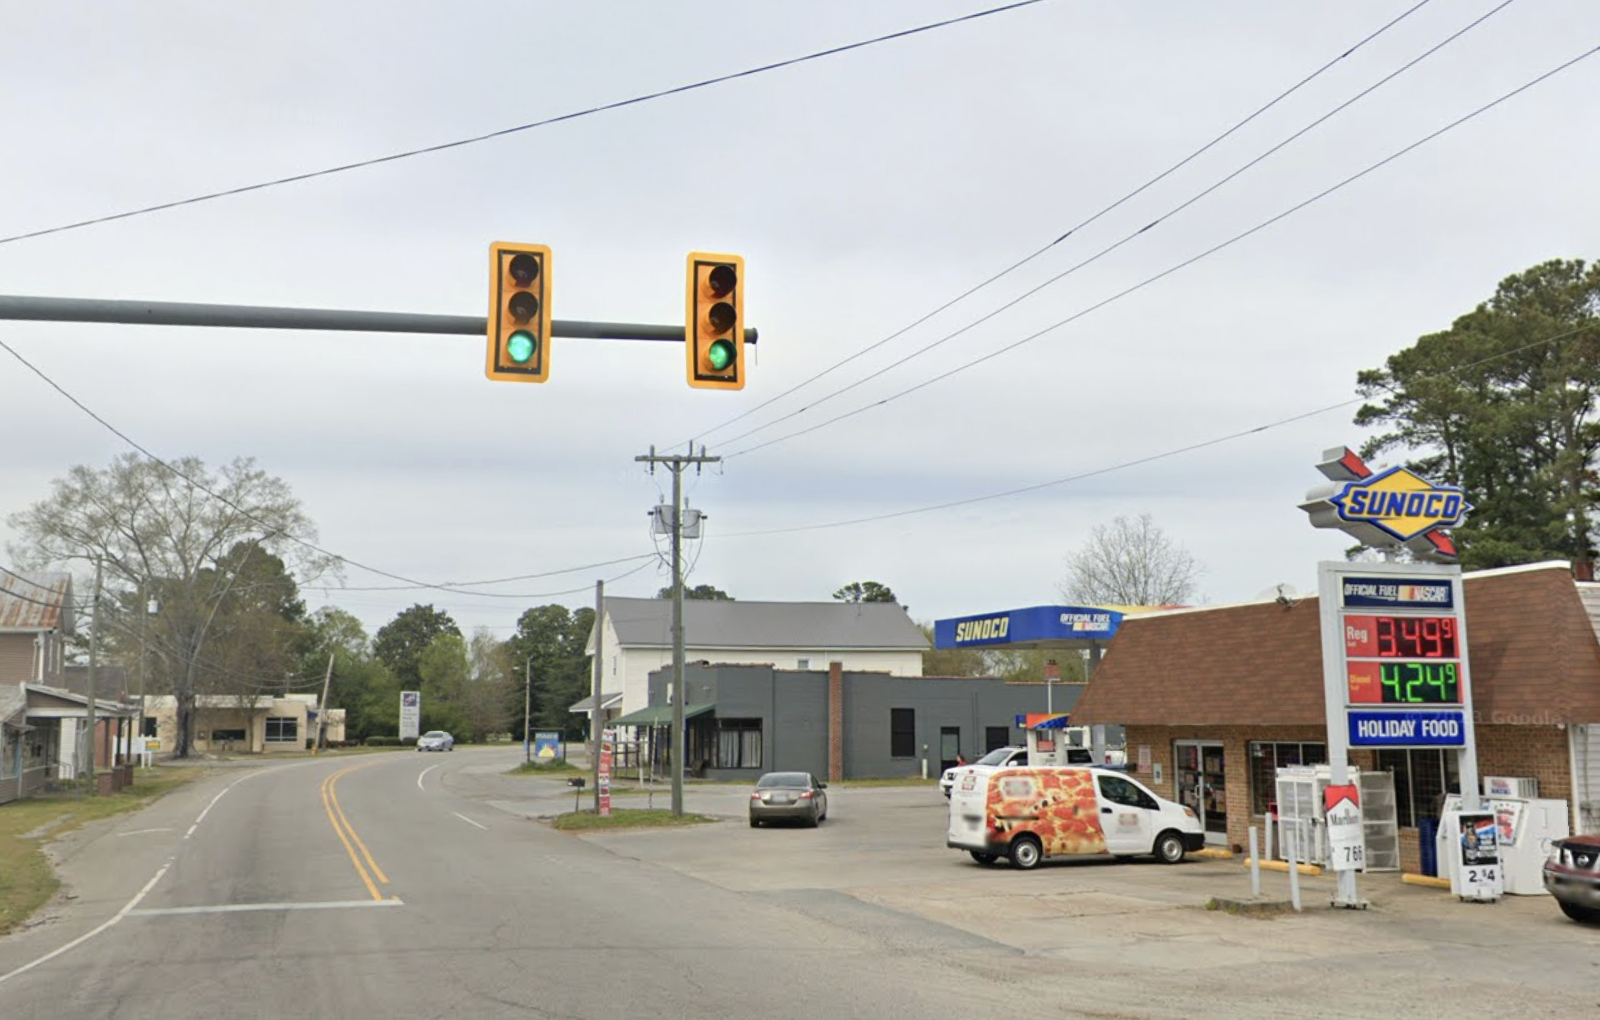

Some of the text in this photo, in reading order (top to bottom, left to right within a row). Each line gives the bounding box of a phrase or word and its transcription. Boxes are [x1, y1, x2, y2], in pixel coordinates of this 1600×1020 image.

[1348, 489, 1461, 518] SUNOCO
[956, 616, 1009, 642] SUNOCO
[1346, 626, 1368, 643] Reg
[1358, 719, 1459, 738] HOLIDAY FOOD
